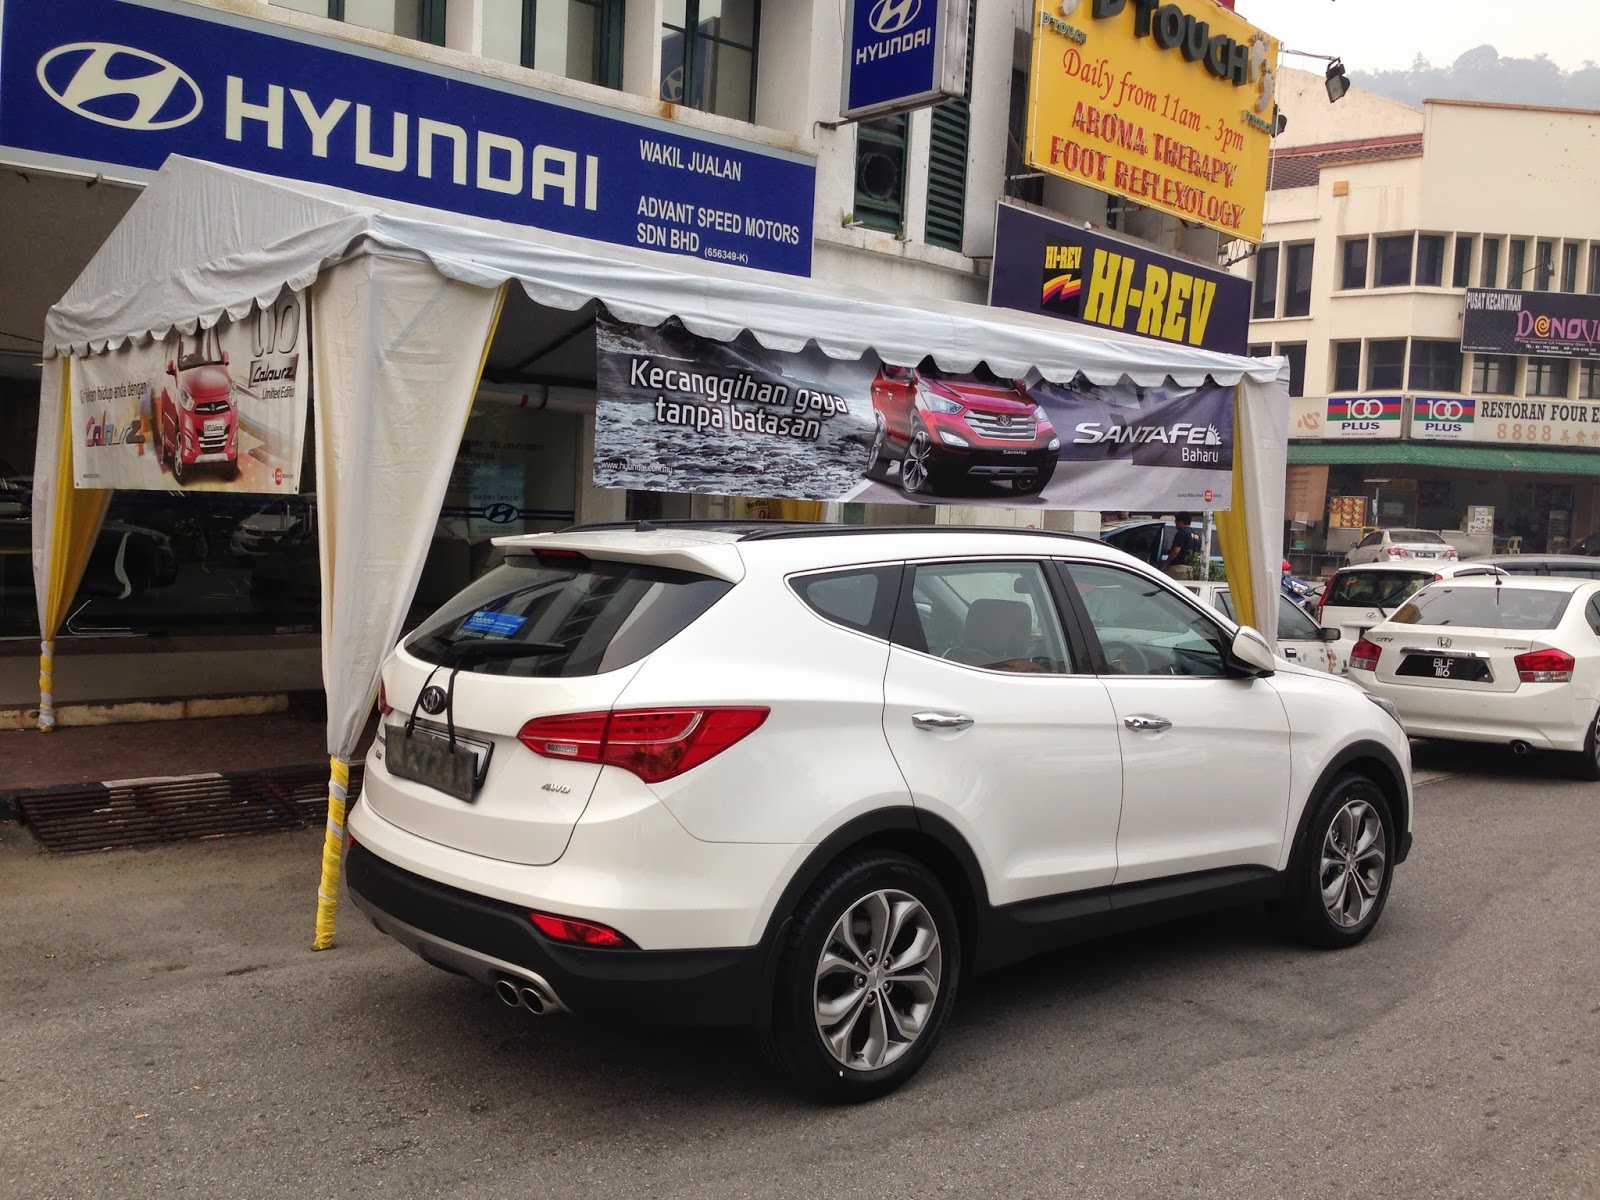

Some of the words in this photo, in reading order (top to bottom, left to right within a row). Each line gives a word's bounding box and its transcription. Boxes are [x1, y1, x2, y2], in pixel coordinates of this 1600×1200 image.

[856, 27, 931, 65] HYUNDAI
[1063, 48, 1114, 100] Daily
[1113, 71, 1157, 112] from
[1161, 94, 1201, 131] 11am
[1215, 118, 1244, 154] 3pm
[225, 75, 598, 210] HYUNDAI
[1072, 101, 1148, 155] AROMA
[1153, 133, 1237, 188] THERAPY
[640, 139, 684, 169] WAKIL
[688, 151, 741, 181] JUALAN
[1050, 135, 1111, 182] FOOT
[1114, 159, 1245, 229] REFLEXOLOGY
[637, 195, 694, 225] ADVANT
[698, 207, 741, 234] SPEED
[745, 217, 799, 245] MOTORS
[637, 222, 666, 246] SDN
[670, 229, 699, 252] BHD
[704, 247, 748, 264] (656349-K)
[1045, 246, 1082, 269] HI-REV
[1083, 248, 1217, 346] HI-REV
[1466, 292, 1485, 310] PUSAT
[1485, 293, 1522, 311] KECANTIKAN
[630, 359, 788, 405] Kecanggihan
[795, 389, 848, 417] gaya
[655, 397, 723, 432] tanpa
[731, 405, 820, 439] batasan
[1346, 399, 1383, 419] 100
[1428, 400, 1463, 420] 100
[1481, 401, 1546, 420] RESTORAN
[1550, 404, 1587, 422] FOUR
[1341, 422, 1380, 431] PLUS
[1425, 423, 1462, 432] PLUS
[1497, 422, 1551, 441] 8888
[1181, 447, 1219, 463] Baharu
[601, 462, 673, 476] www.hyundai.com.my
[473, 493, 519, 502] experience
[1433, 657, 1454, 668] BLF
[1435, 667, 1450, 677] 1116
[541, 783, 571, 794] 4WD
